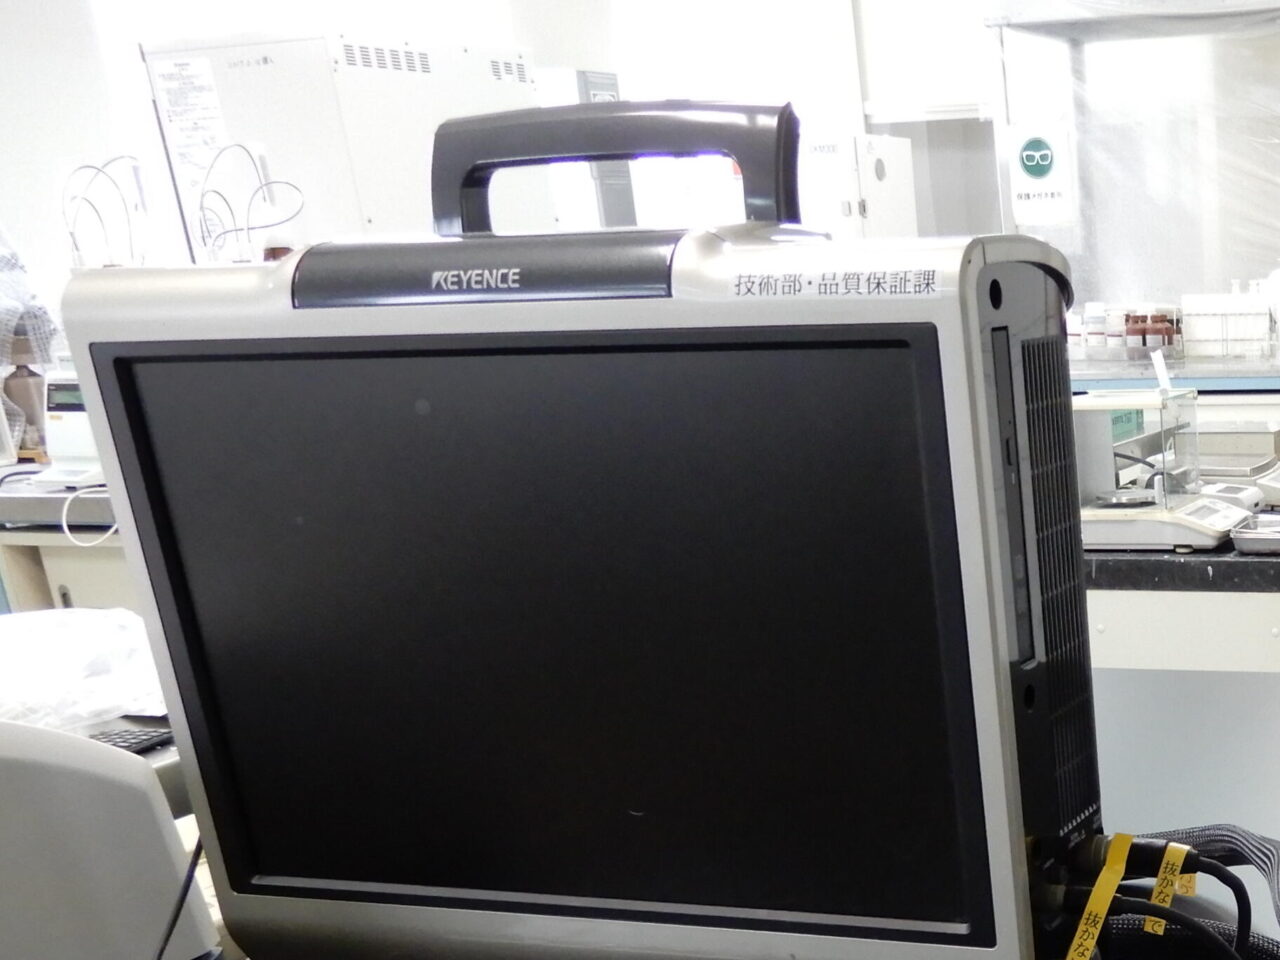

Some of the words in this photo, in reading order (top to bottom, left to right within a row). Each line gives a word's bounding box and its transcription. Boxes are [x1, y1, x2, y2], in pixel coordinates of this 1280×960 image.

[431, 268, 521, 290] KEYENCE
[734, 269, 936, 297] 技術部・品質保証課
